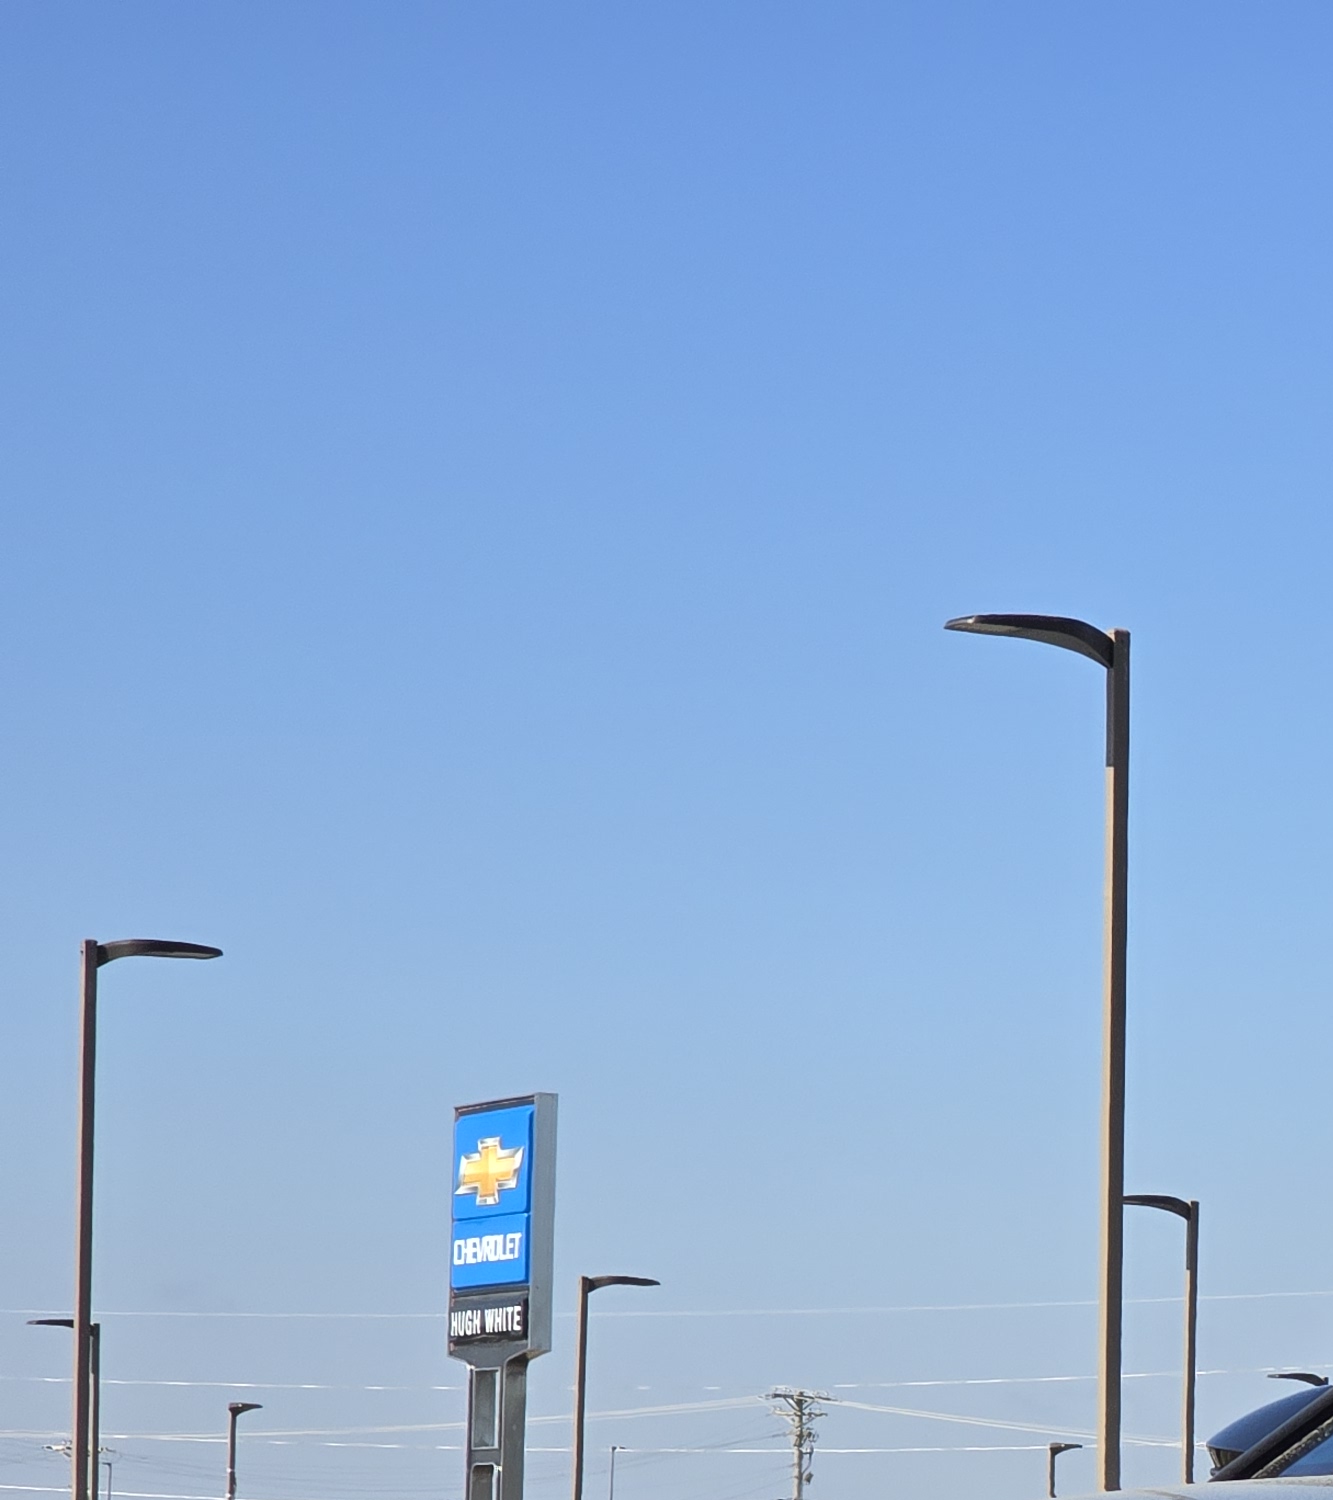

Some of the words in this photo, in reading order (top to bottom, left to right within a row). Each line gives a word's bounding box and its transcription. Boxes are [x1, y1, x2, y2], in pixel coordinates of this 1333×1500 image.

[453, 1232, 522, 1265] CHEVROLET
[450, 1310, 481, 1337] HUGH
[484, 1305, 522, 1333] WHITE
